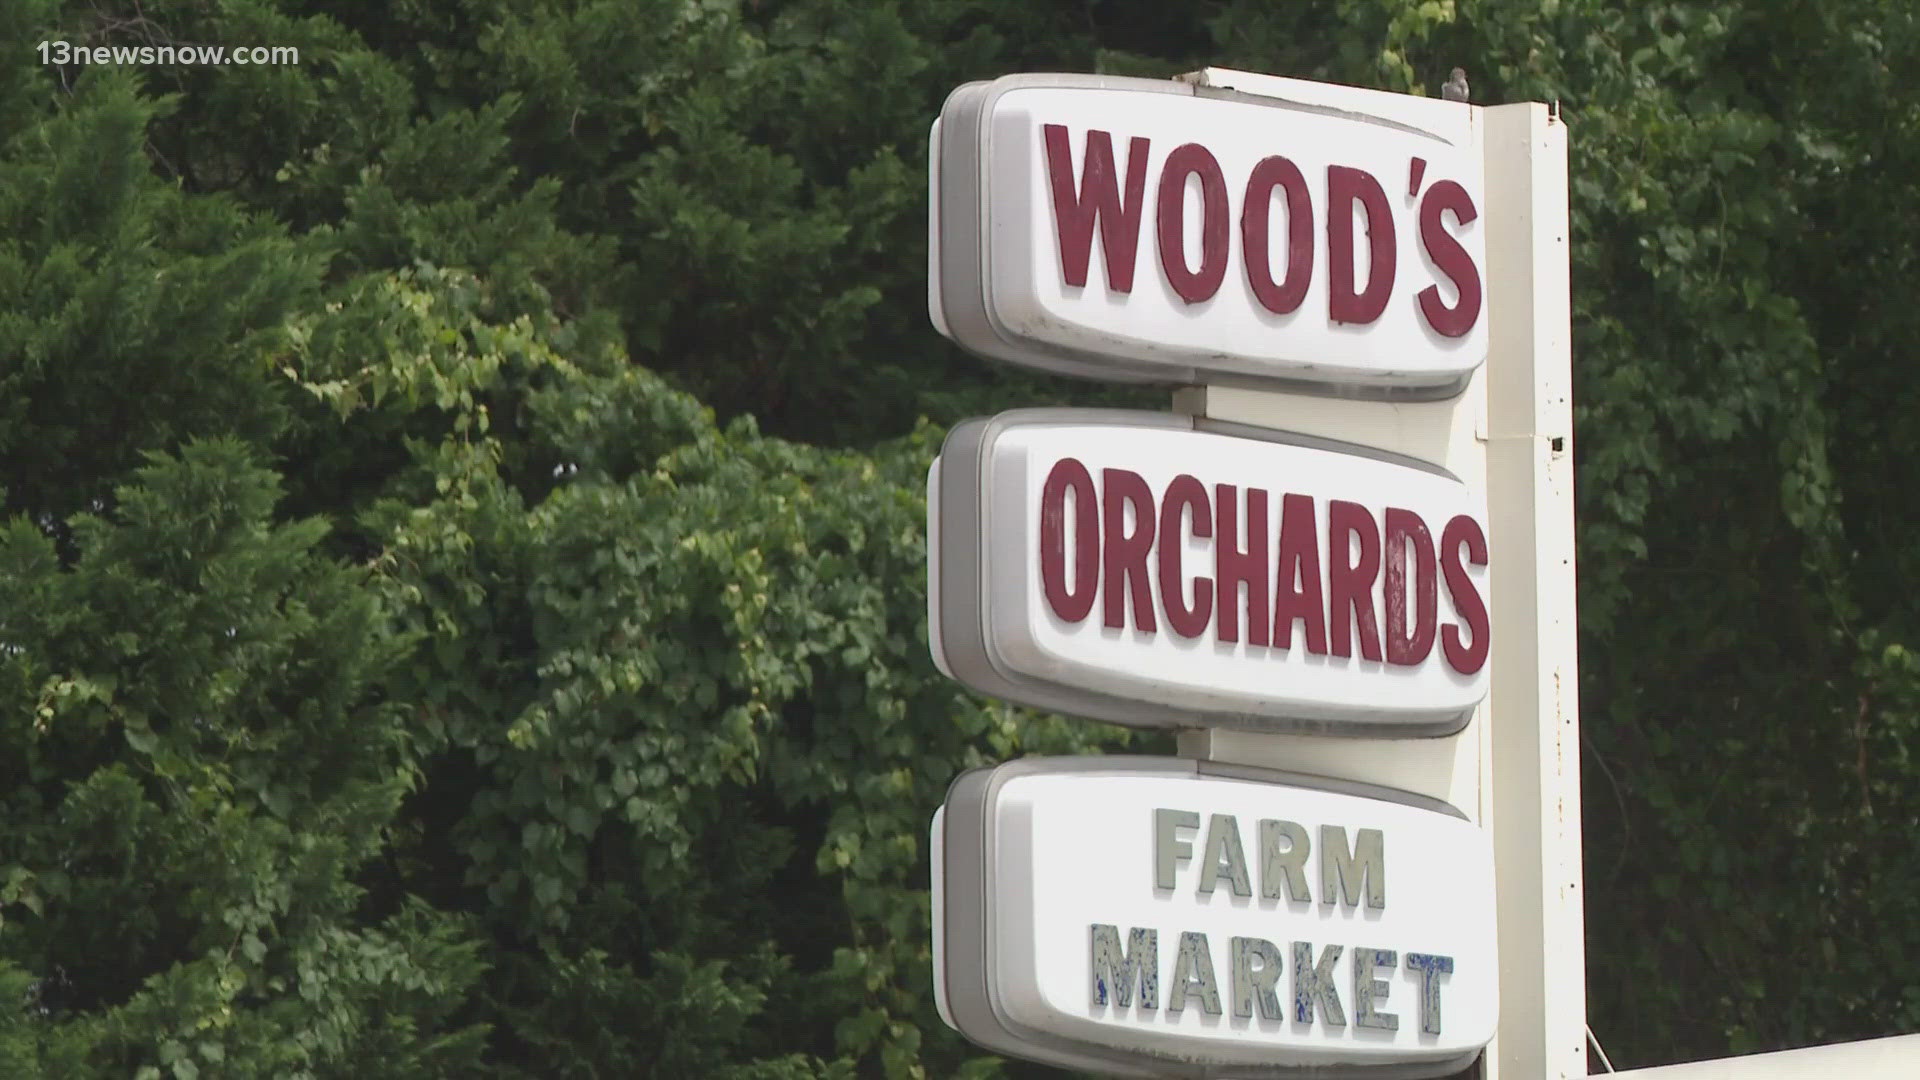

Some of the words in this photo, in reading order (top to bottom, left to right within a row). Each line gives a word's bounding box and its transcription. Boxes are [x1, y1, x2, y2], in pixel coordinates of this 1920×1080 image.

[1044, 124, 1482, 337] WOOD'S
[1040, 458, 1490, 675] ORCHARDS
[1154, 808, 1386, 911] FARM
[1090, 924, 1454, 1035] MARKET
